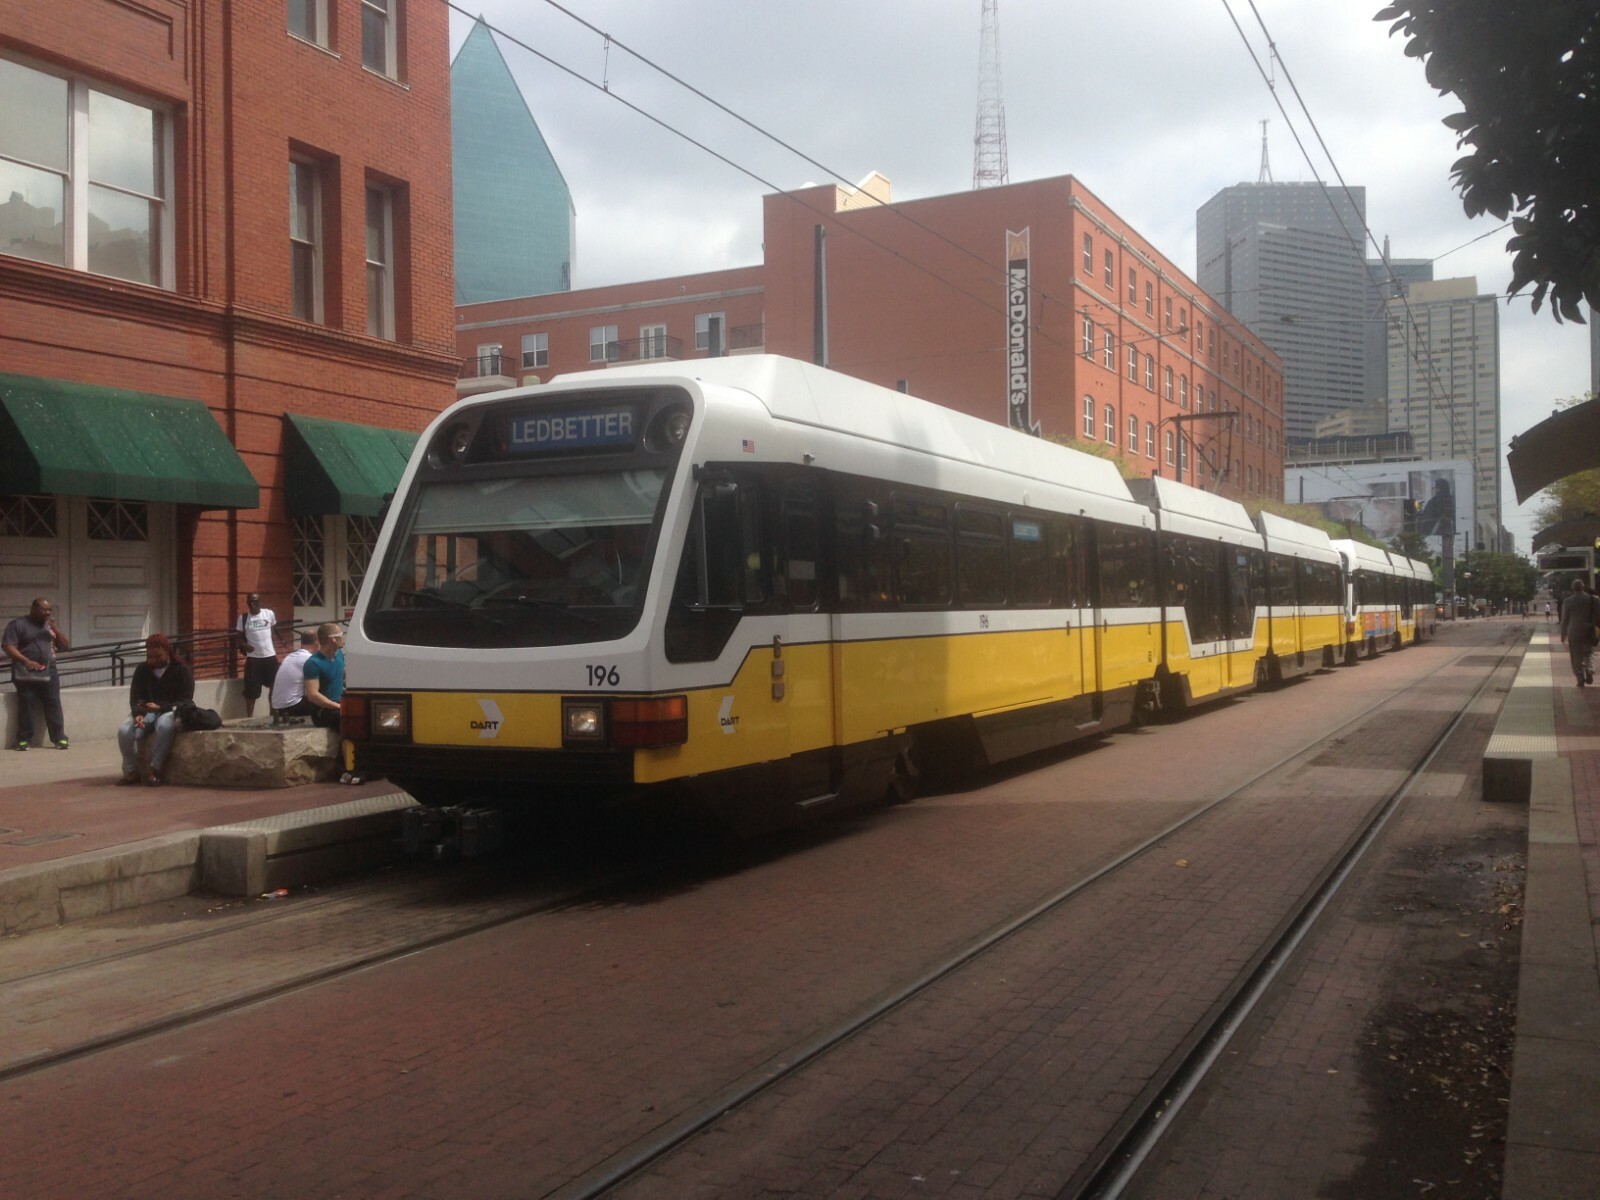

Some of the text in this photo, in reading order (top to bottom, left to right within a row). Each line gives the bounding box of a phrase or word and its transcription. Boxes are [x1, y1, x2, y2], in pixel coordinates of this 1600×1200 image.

[1010, 268, 1027, 405] McDonald's
[512, 412, 632, 443] LEDBETTER
[586, 665, 620, 686] 196
[470, 720, 499, 730] DART
[720, 716, 740, 727] DART
